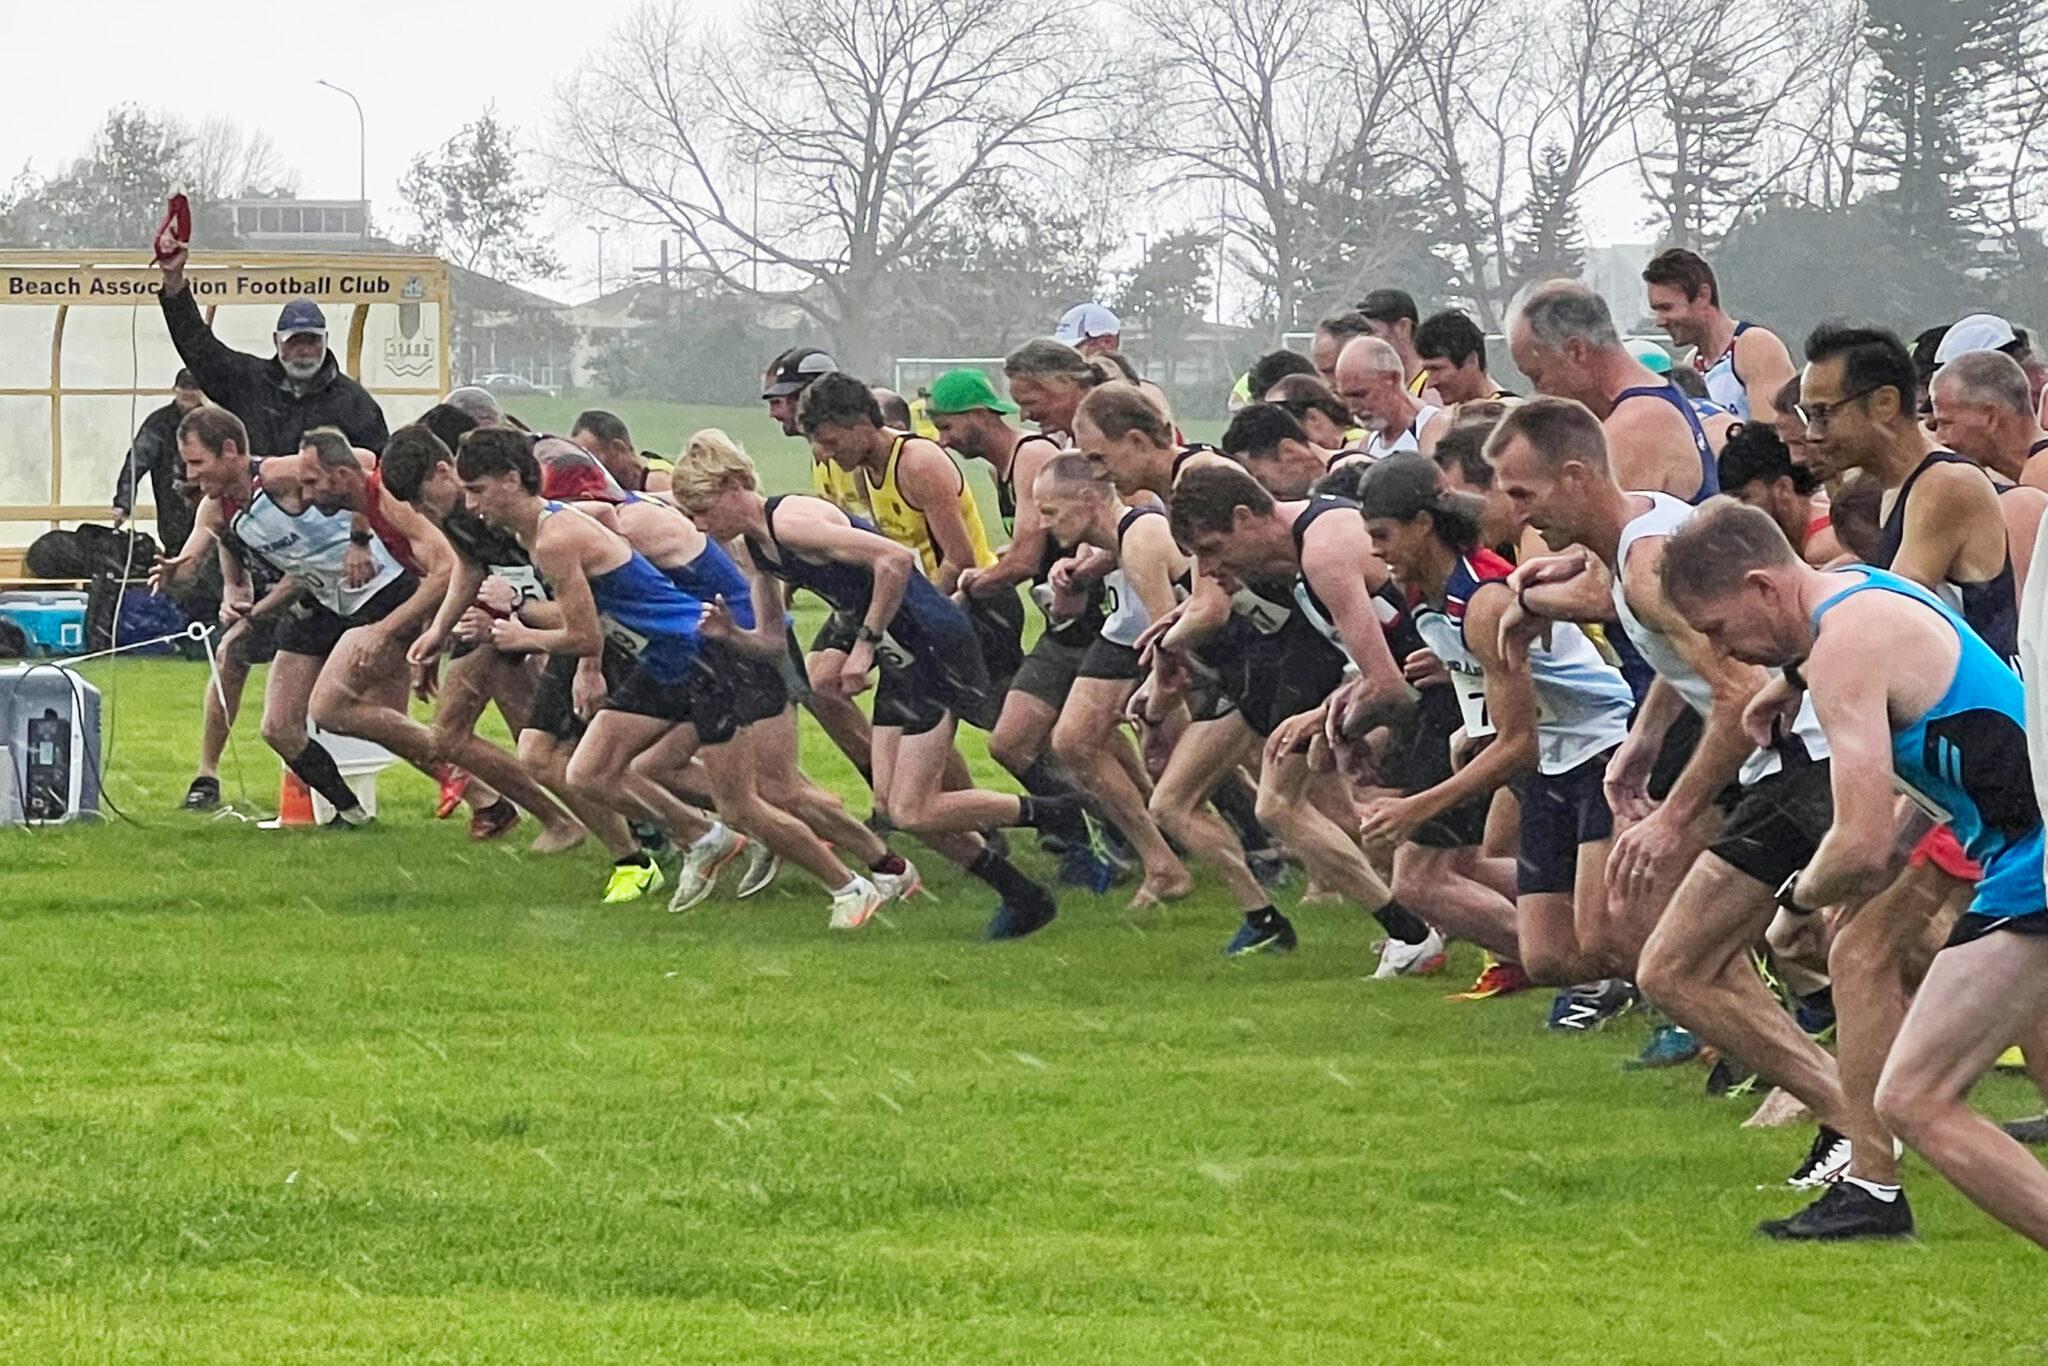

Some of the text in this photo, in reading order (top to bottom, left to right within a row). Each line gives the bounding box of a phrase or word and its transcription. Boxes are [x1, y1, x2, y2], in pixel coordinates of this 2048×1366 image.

[9, 275, 390, 295] Beach Associon Football Club
